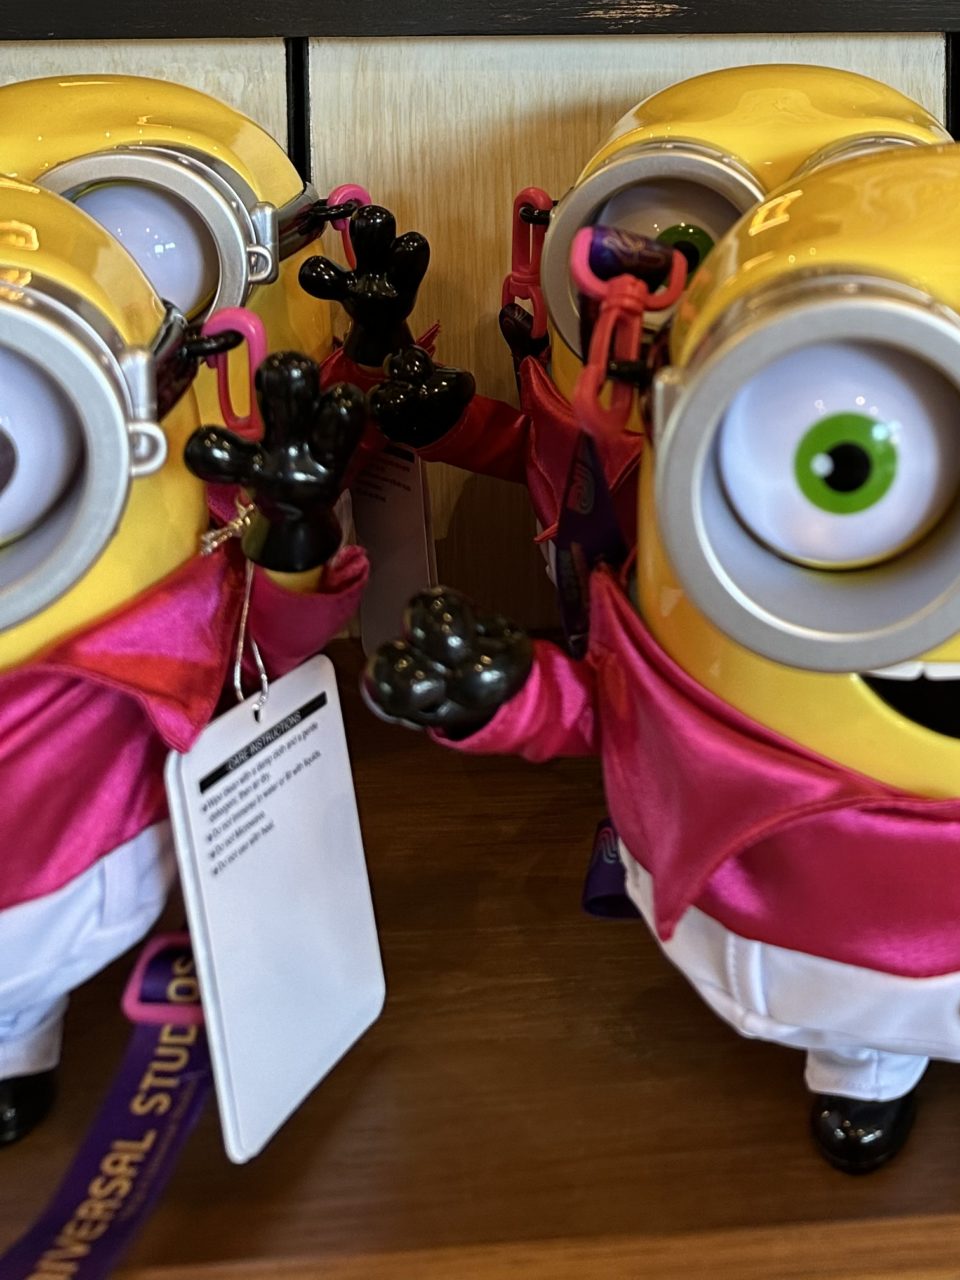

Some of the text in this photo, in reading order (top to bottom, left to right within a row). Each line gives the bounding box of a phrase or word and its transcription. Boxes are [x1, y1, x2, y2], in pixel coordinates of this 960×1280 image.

[228, 709, 302, 770] CARE INSTRUCTIONS
[130, 956, 199, 1116] STUDOS
